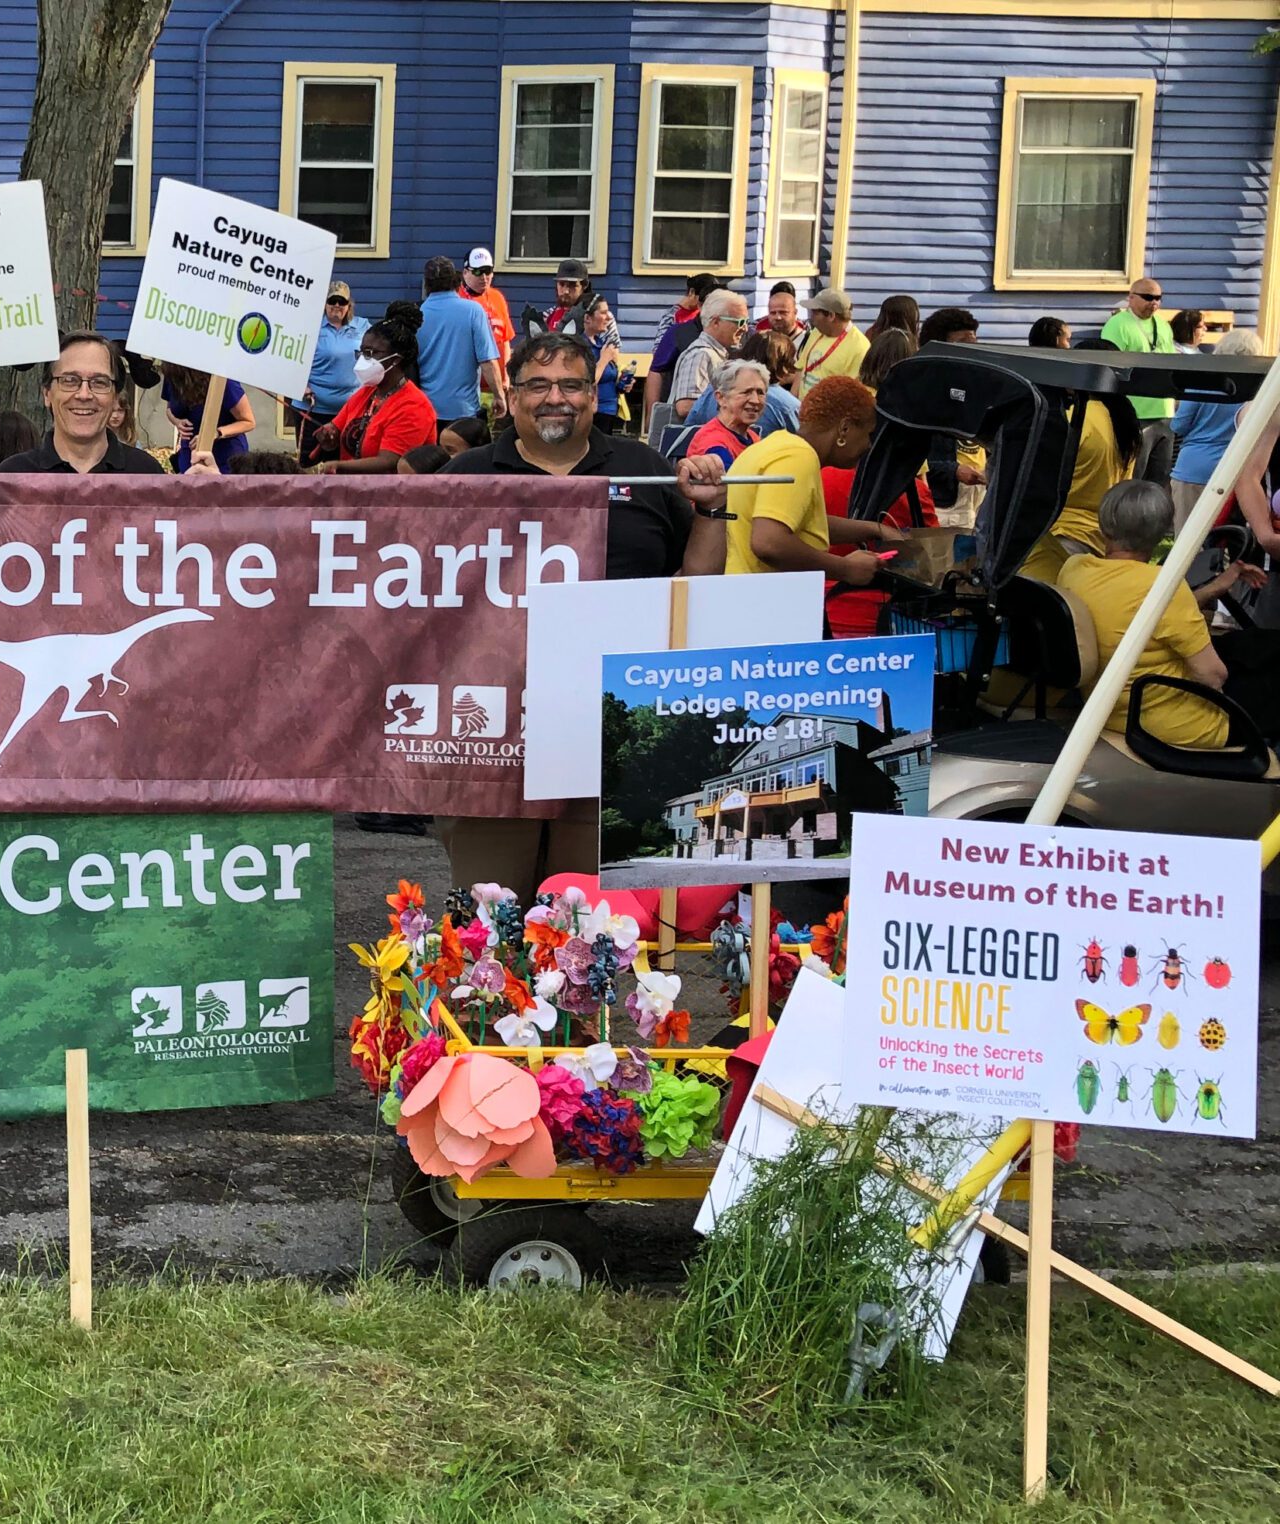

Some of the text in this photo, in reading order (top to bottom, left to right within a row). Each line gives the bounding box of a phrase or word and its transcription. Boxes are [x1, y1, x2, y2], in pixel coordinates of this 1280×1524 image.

[213, 216, 289, 254] Cayuga
[171, 231, 314, 291] Nature Center
[177, 261, 301, 308] proud member of the
[144, 286, 309, 365] Discovery Trail
[114, 519, 278, 609] the
[308, 519, 580, 609] Earth
[625, 652, 915, 690] Cayuga Nature Center
[656, 684, 883, 719] Lodge Reopening
[713, 718, 823, 744] June 18!
[405, 753, 470, 766] RESEARCH
[941, 837, 1170, 877] New Exhibit at
[884, 870, 1225, 919] Museum of the Earth!
[883, 920, 1060, 982] SIX-LEGGED
[880, 975, 1012, 1035] SCIENCE
[133, 1028, 311, 1055] PALEONTOLOGICAL
[154, 1045, 290, 1061] RESEARCH INSTITUTION
[879, 1036, 1044, 1063] Unlocking the Secrets
[879, 1056, 1025, 1081] of the Insect World
[955, 1085, 1041, 1099] CORNELL UNIVERSITY
[956, 1095, 1041, 1108] INSECT COLLECTION
